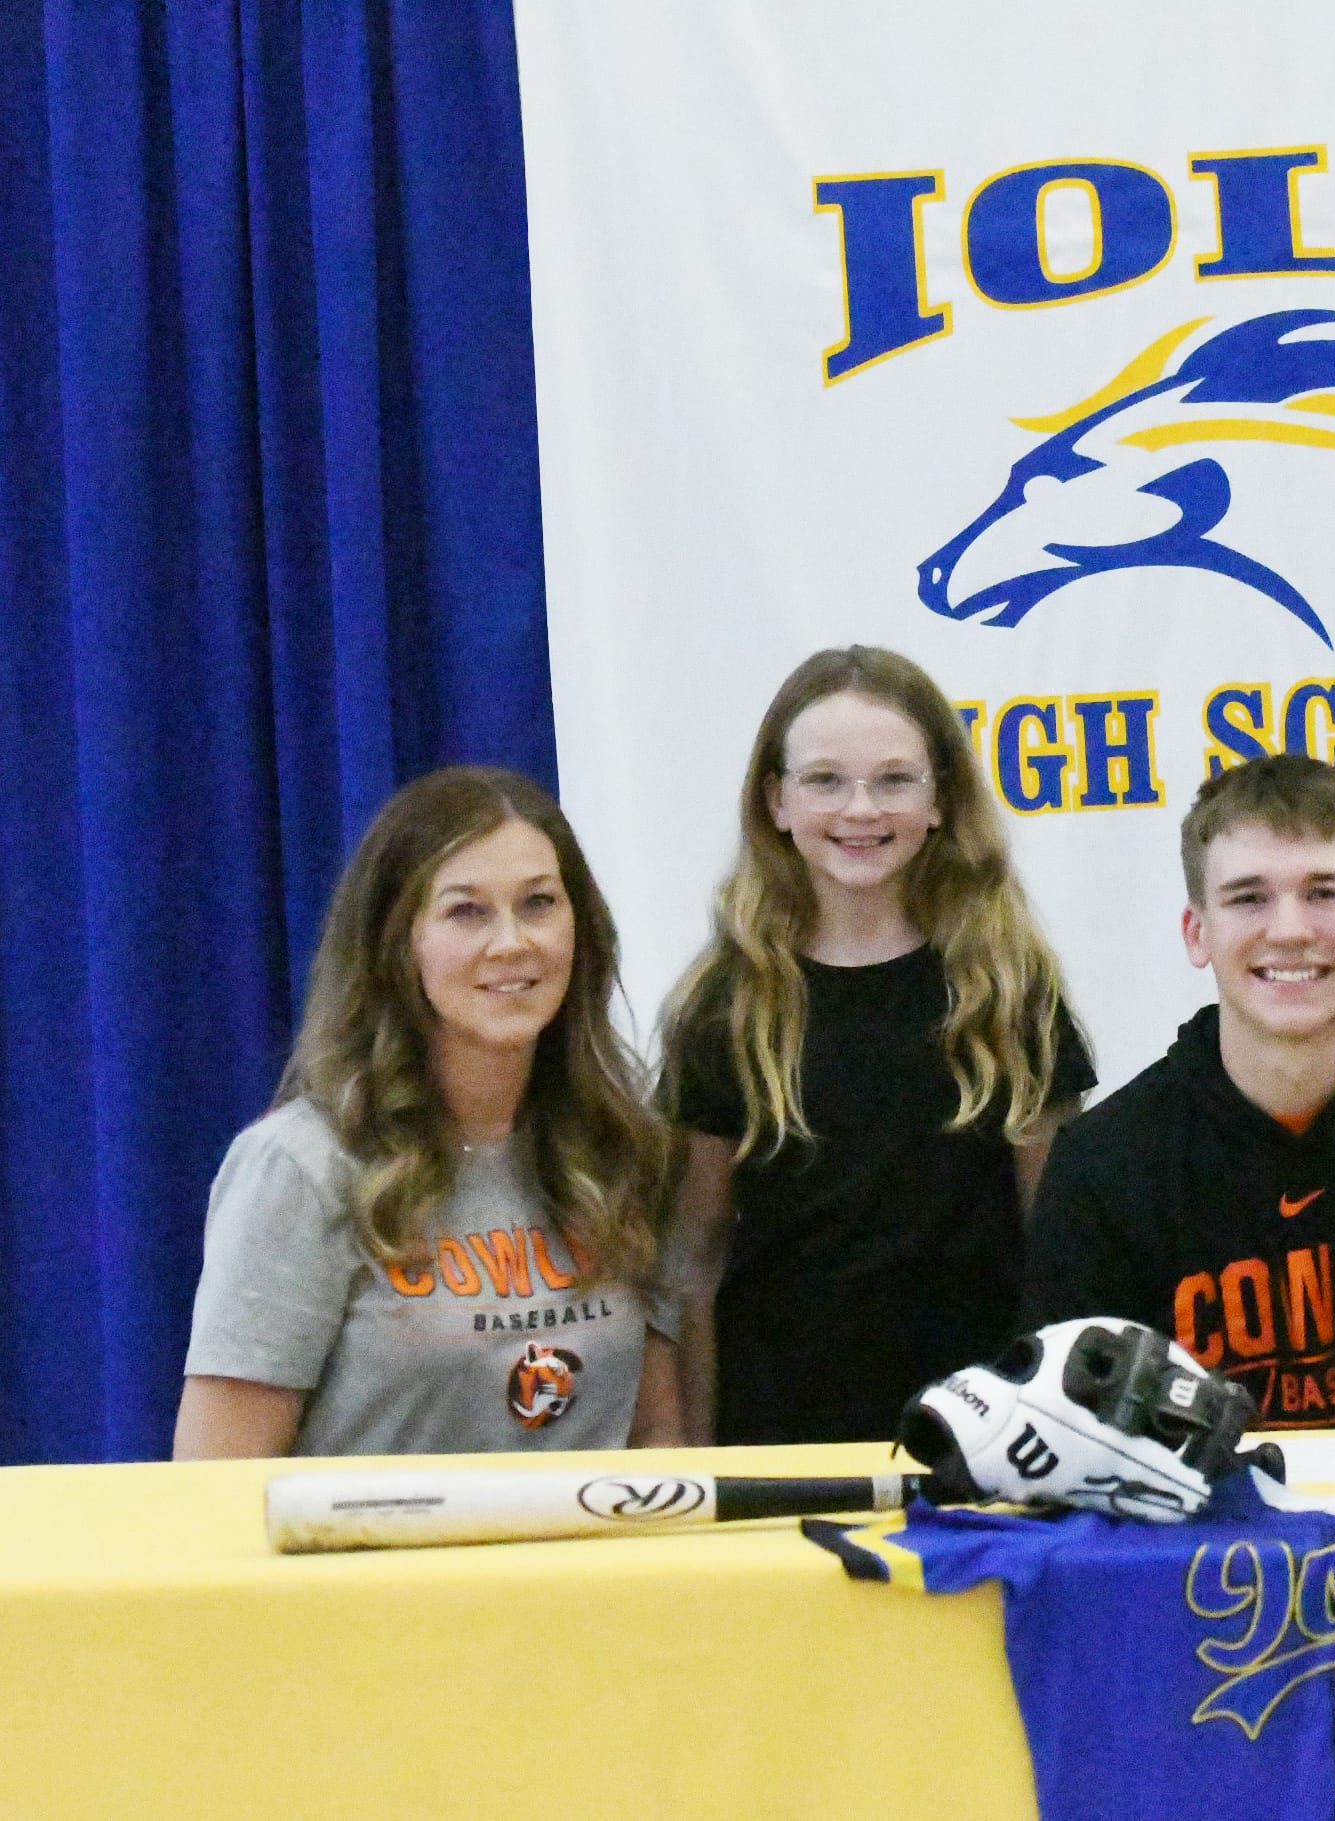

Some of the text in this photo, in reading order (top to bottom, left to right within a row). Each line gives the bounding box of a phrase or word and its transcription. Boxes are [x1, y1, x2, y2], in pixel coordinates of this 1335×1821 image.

[956, 689, 1167, 817] GH
[388, 1226, 593, 1298] COWL
[473, 1299, 613, 1332] BASEBALL
